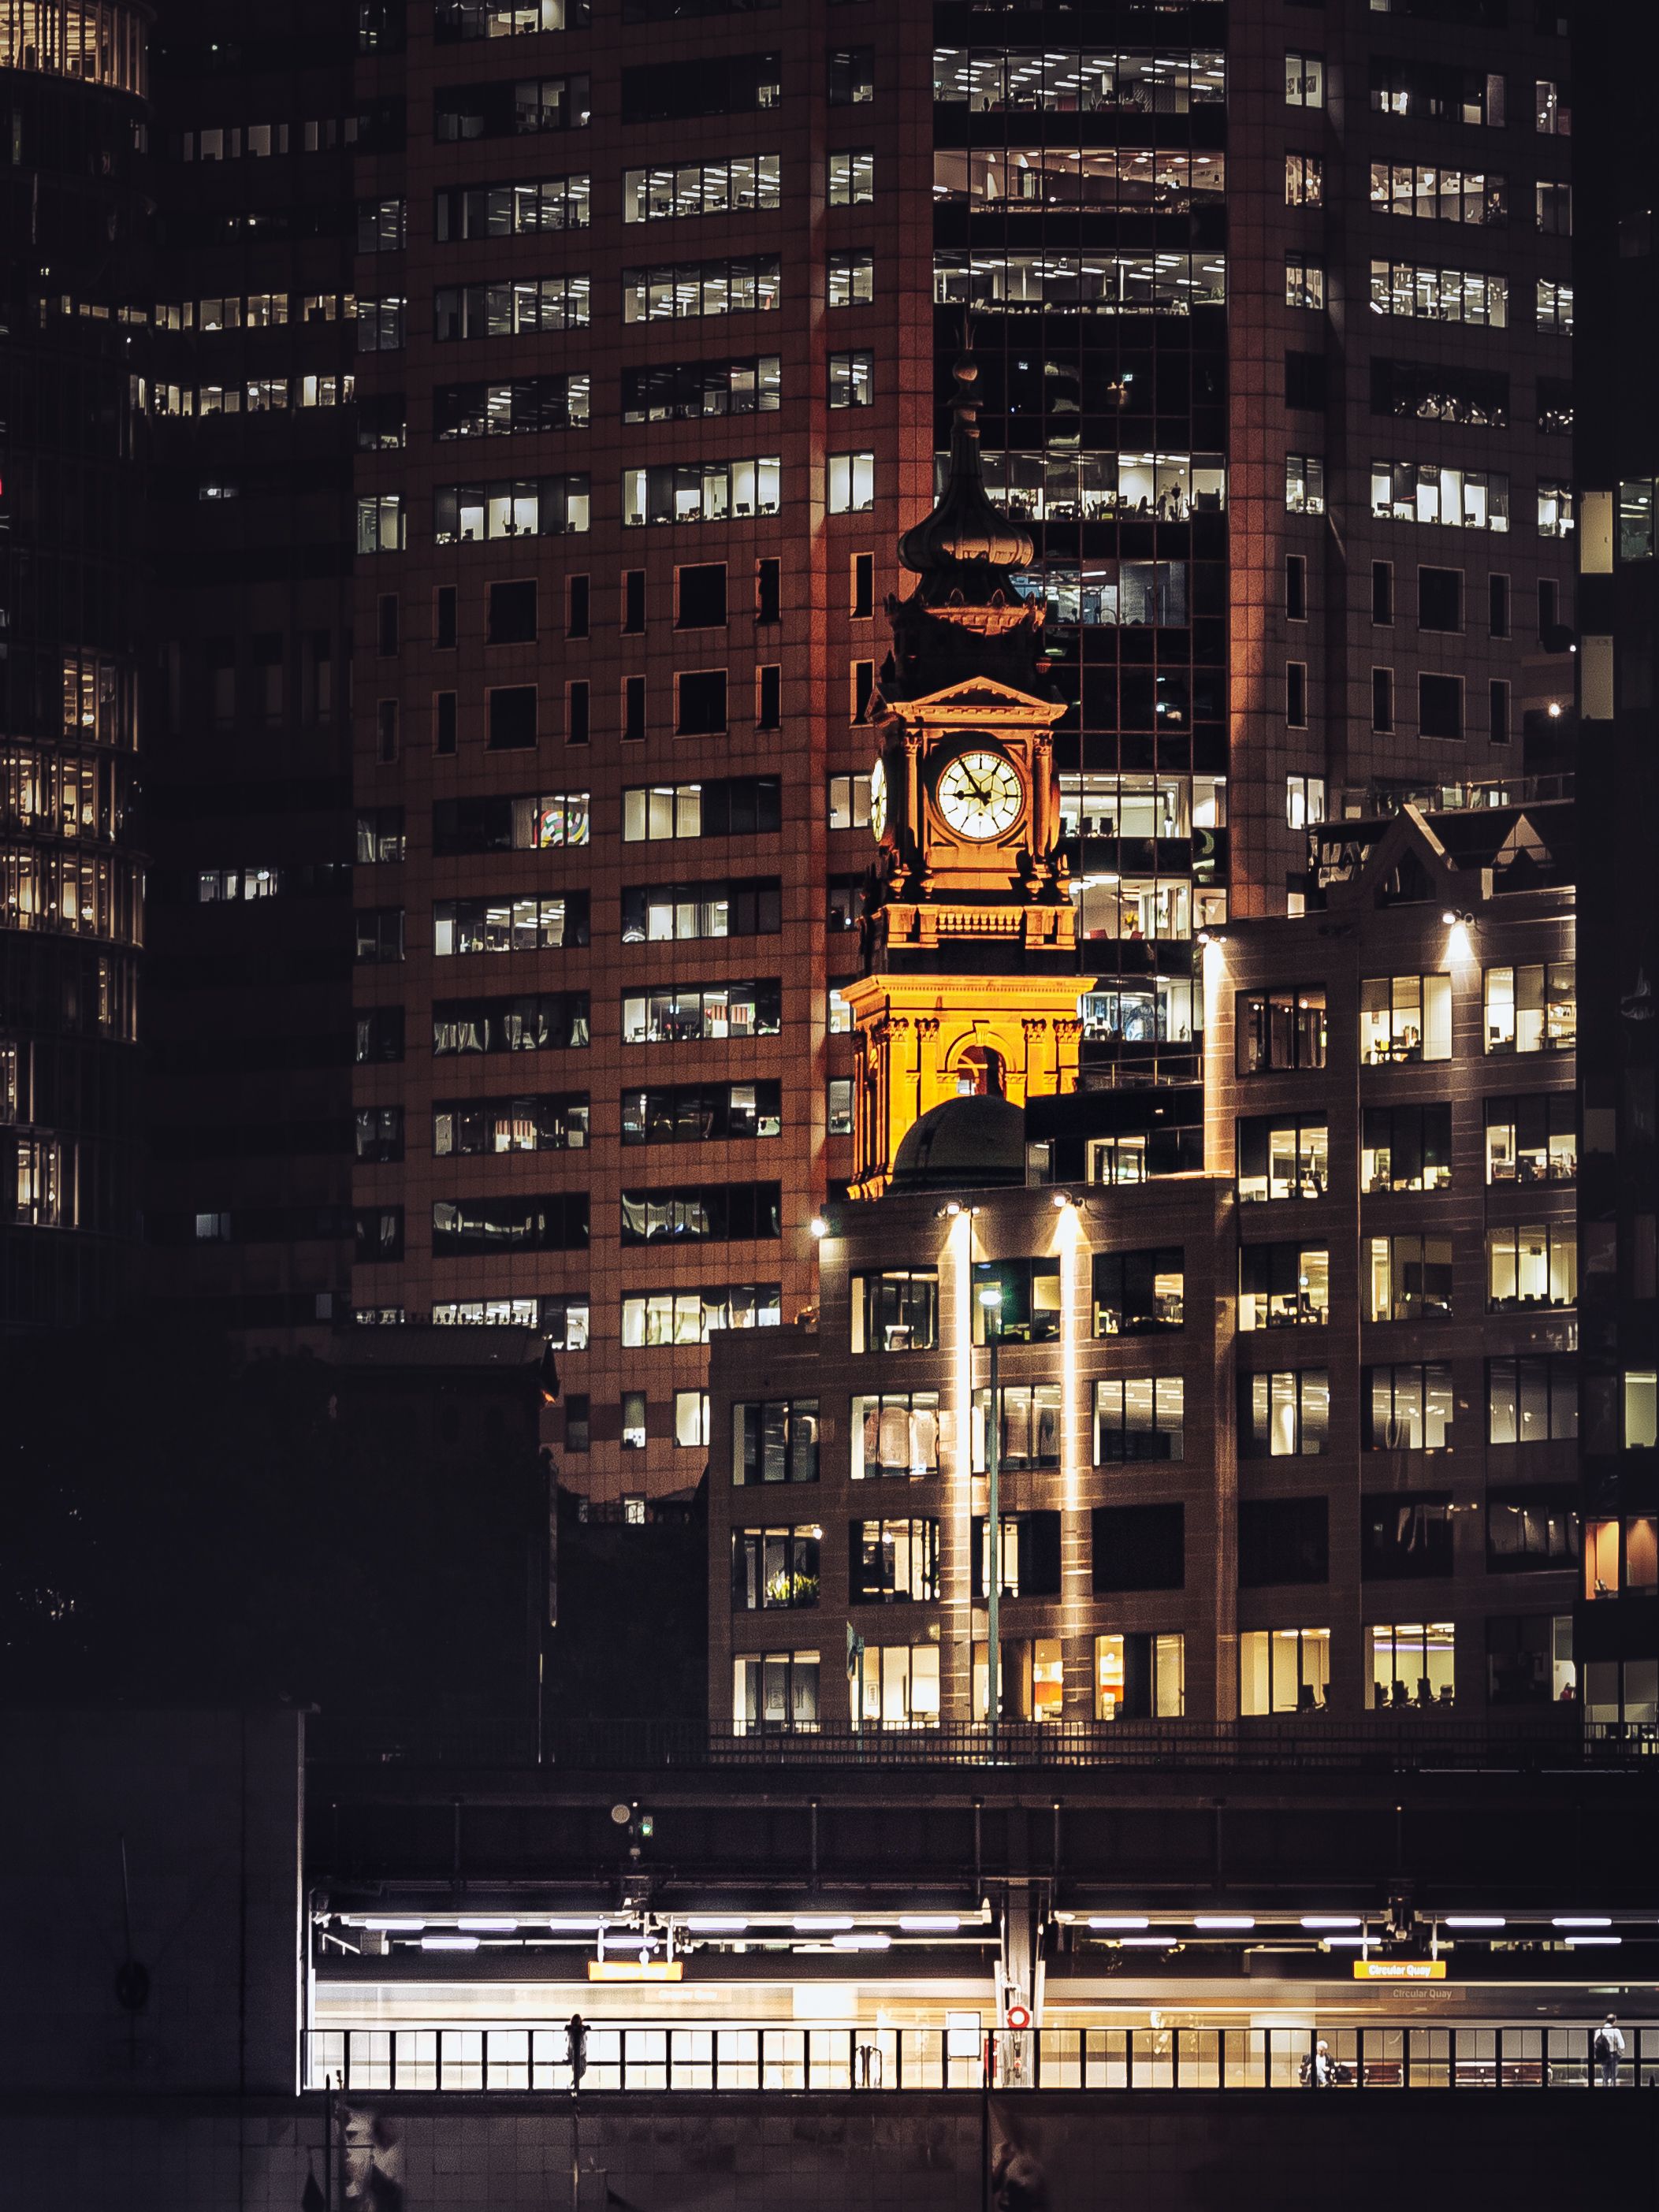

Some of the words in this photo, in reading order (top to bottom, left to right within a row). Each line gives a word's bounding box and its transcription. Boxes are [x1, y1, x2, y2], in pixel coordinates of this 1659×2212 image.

[1368, 1965, 1405, 1976] Circular
[1407, 1965, 1430, 1977] Quay
[1393, 1989, 1427, 1998] Circular
[1429, 1989, 1453, 1999] Quay
